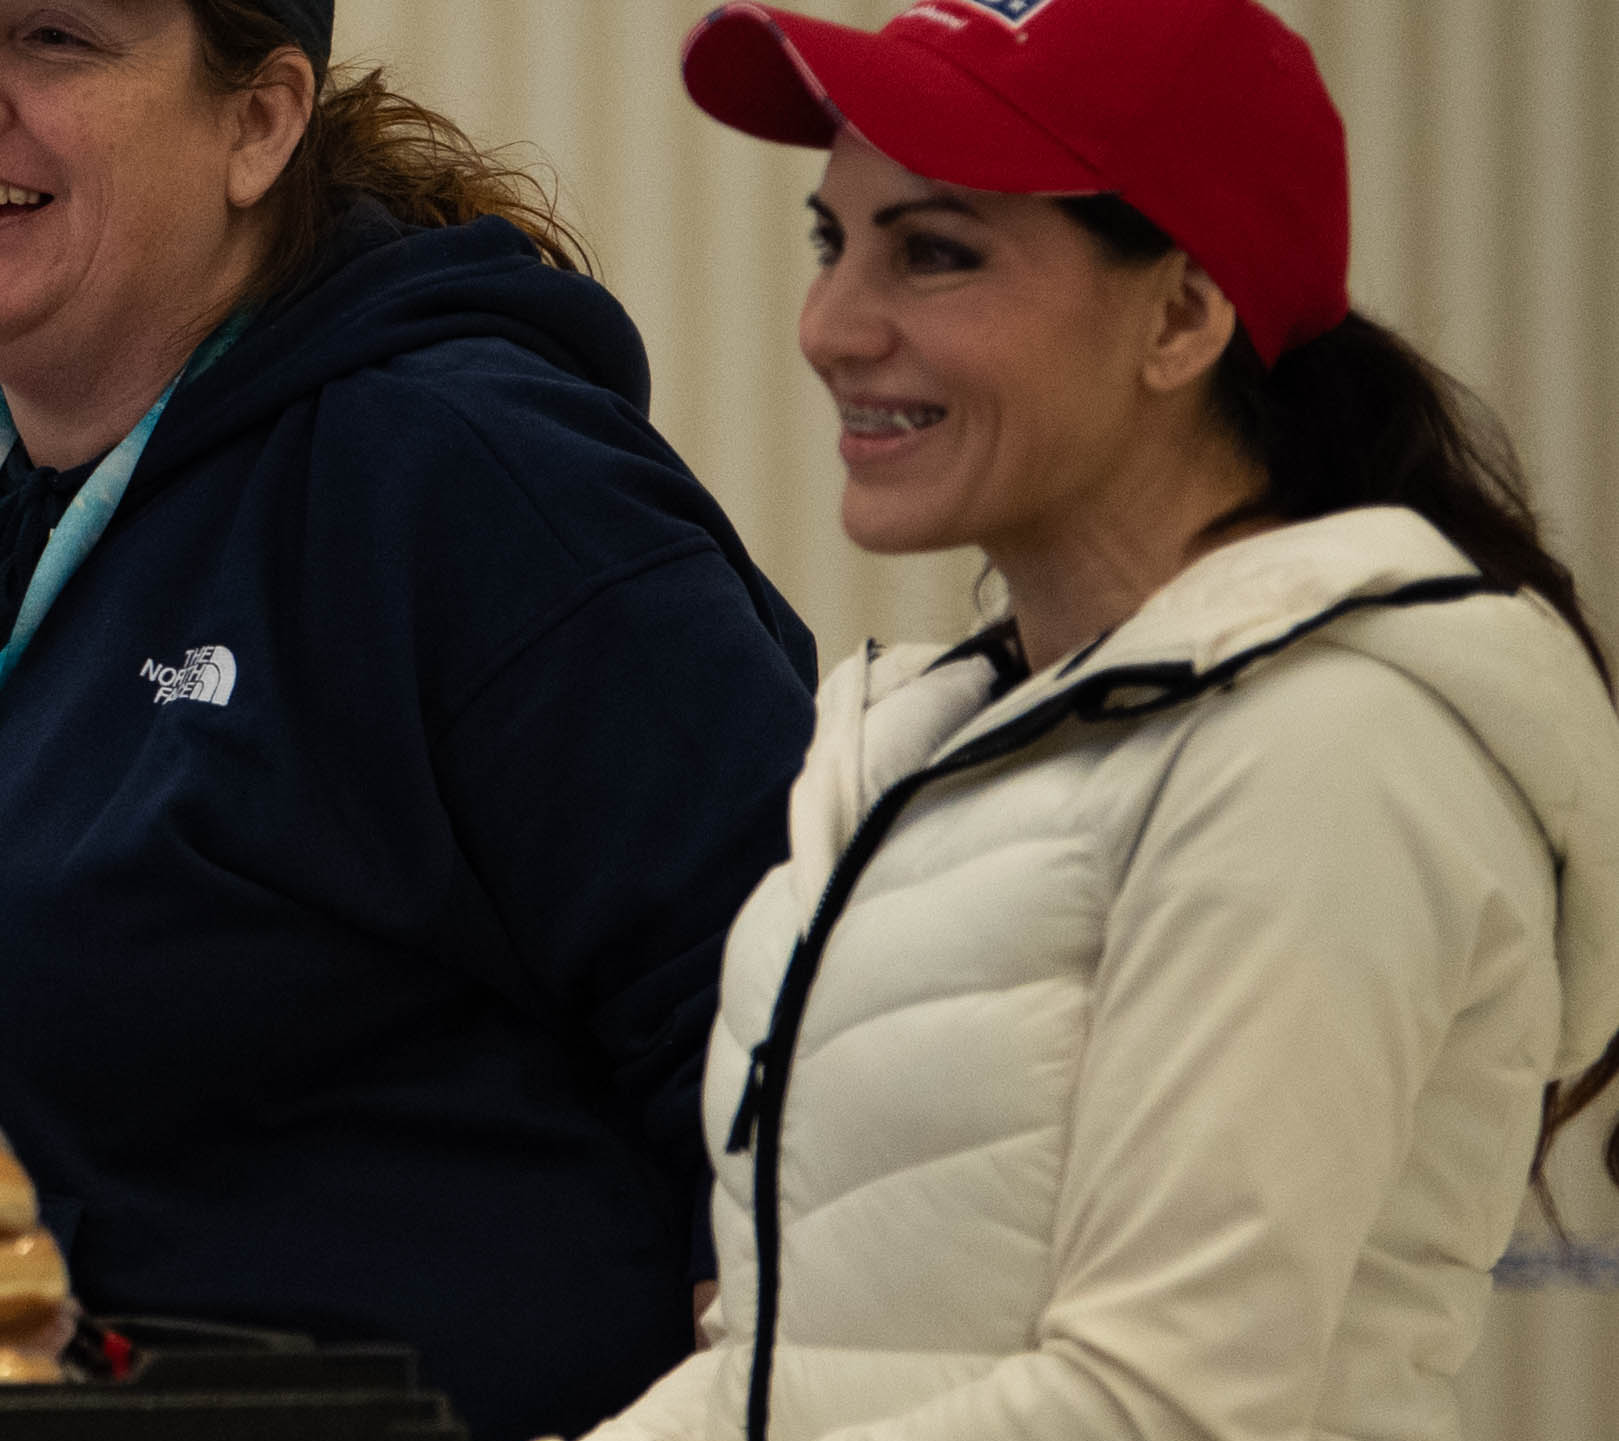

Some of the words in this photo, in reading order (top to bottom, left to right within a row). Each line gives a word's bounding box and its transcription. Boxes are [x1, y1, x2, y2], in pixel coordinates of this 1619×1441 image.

[184, 646, 215, 666] THE
[140, 658, 206, 687] NORTH
[153, 681, 195, 705] FACE
